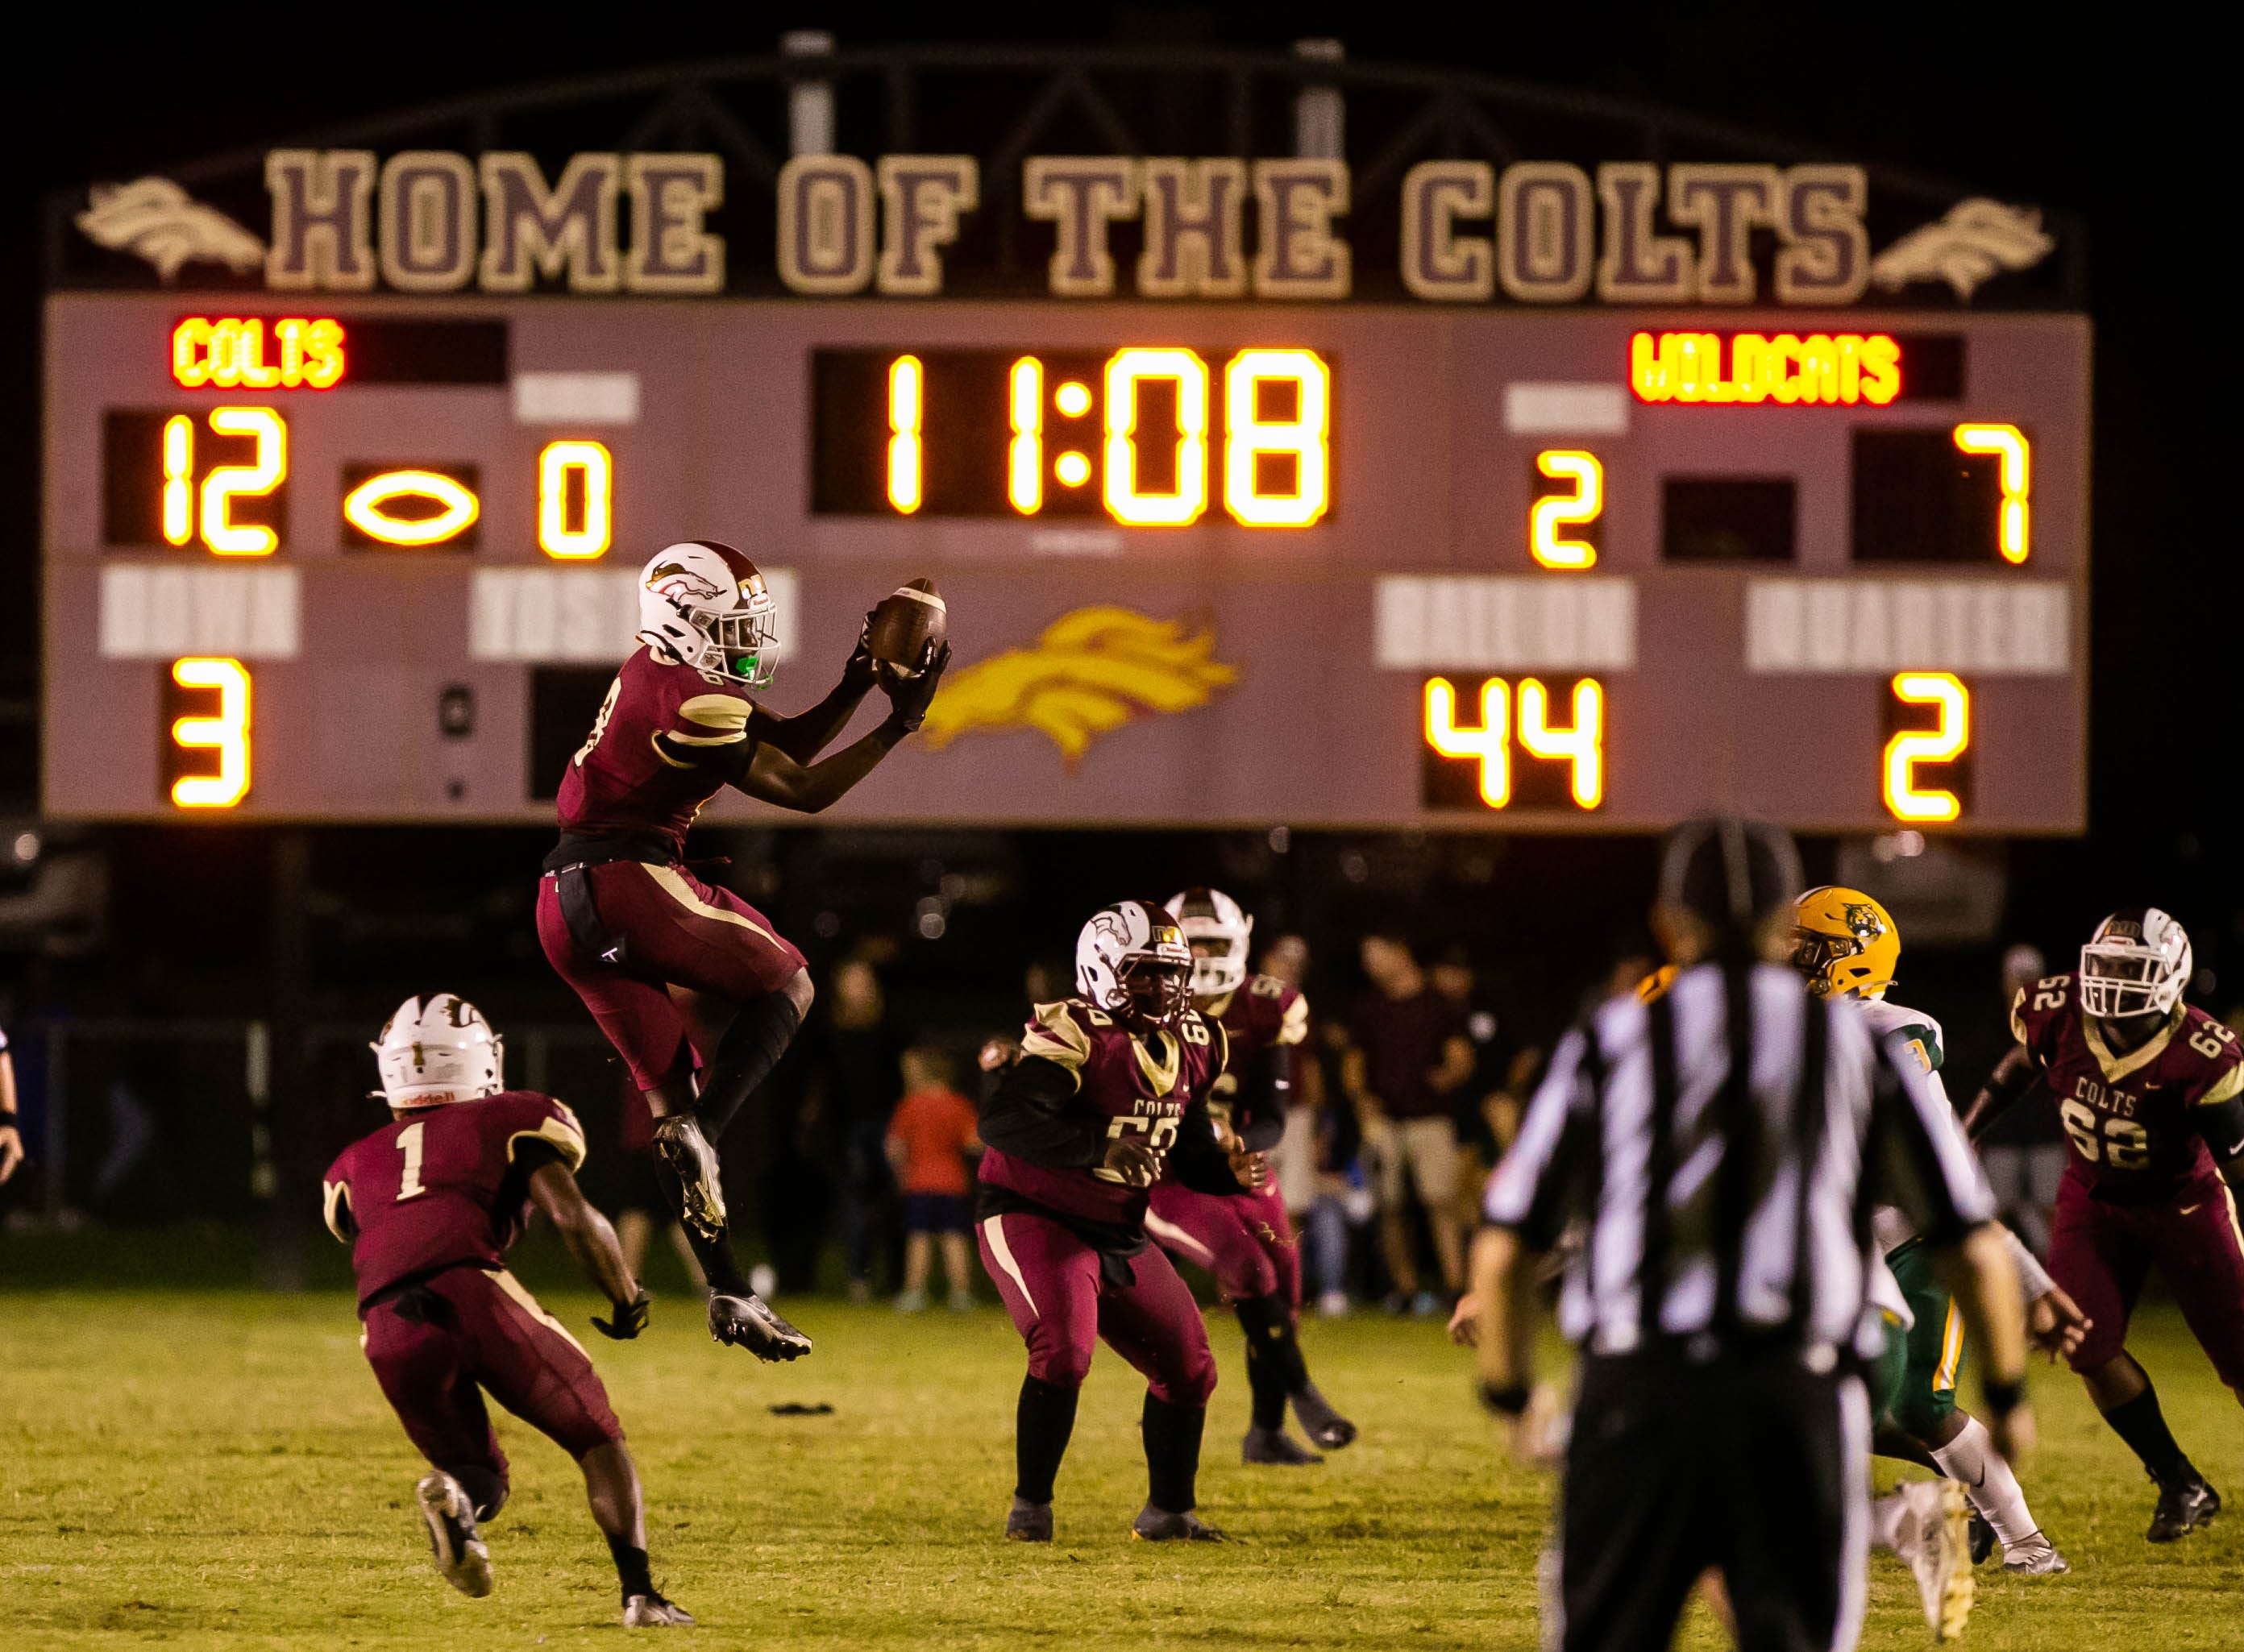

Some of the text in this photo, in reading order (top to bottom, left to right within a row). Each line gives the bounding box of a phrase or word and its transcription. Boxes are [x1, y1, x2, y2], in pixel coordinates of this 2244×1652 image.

[264, 149, 1870, 303] HOME OF THE COLTS
[172, 317, 345, 388] COLTS
[1628, 331, 1902, 407] WILDCATS
[162, 405, 288, 557] 12
[887, 347, 1330, 528] 11:08
[1953, 423, 2030, 564] 7
[538, 439, 613, 560] 0
[1529, 449, 1603, 569] 2
[171, 657, 251, 808] 3
[1424, 677, 1603, 808] 44
[1883, 670, 1969, 823] 2
[2076, 1077, 2136, 1117] COLTS
[2189, 1020, 2235, 1059] 62
[396, 1121, 426, 1201] 1
[2061, 1098, 2150, 1169] 62
